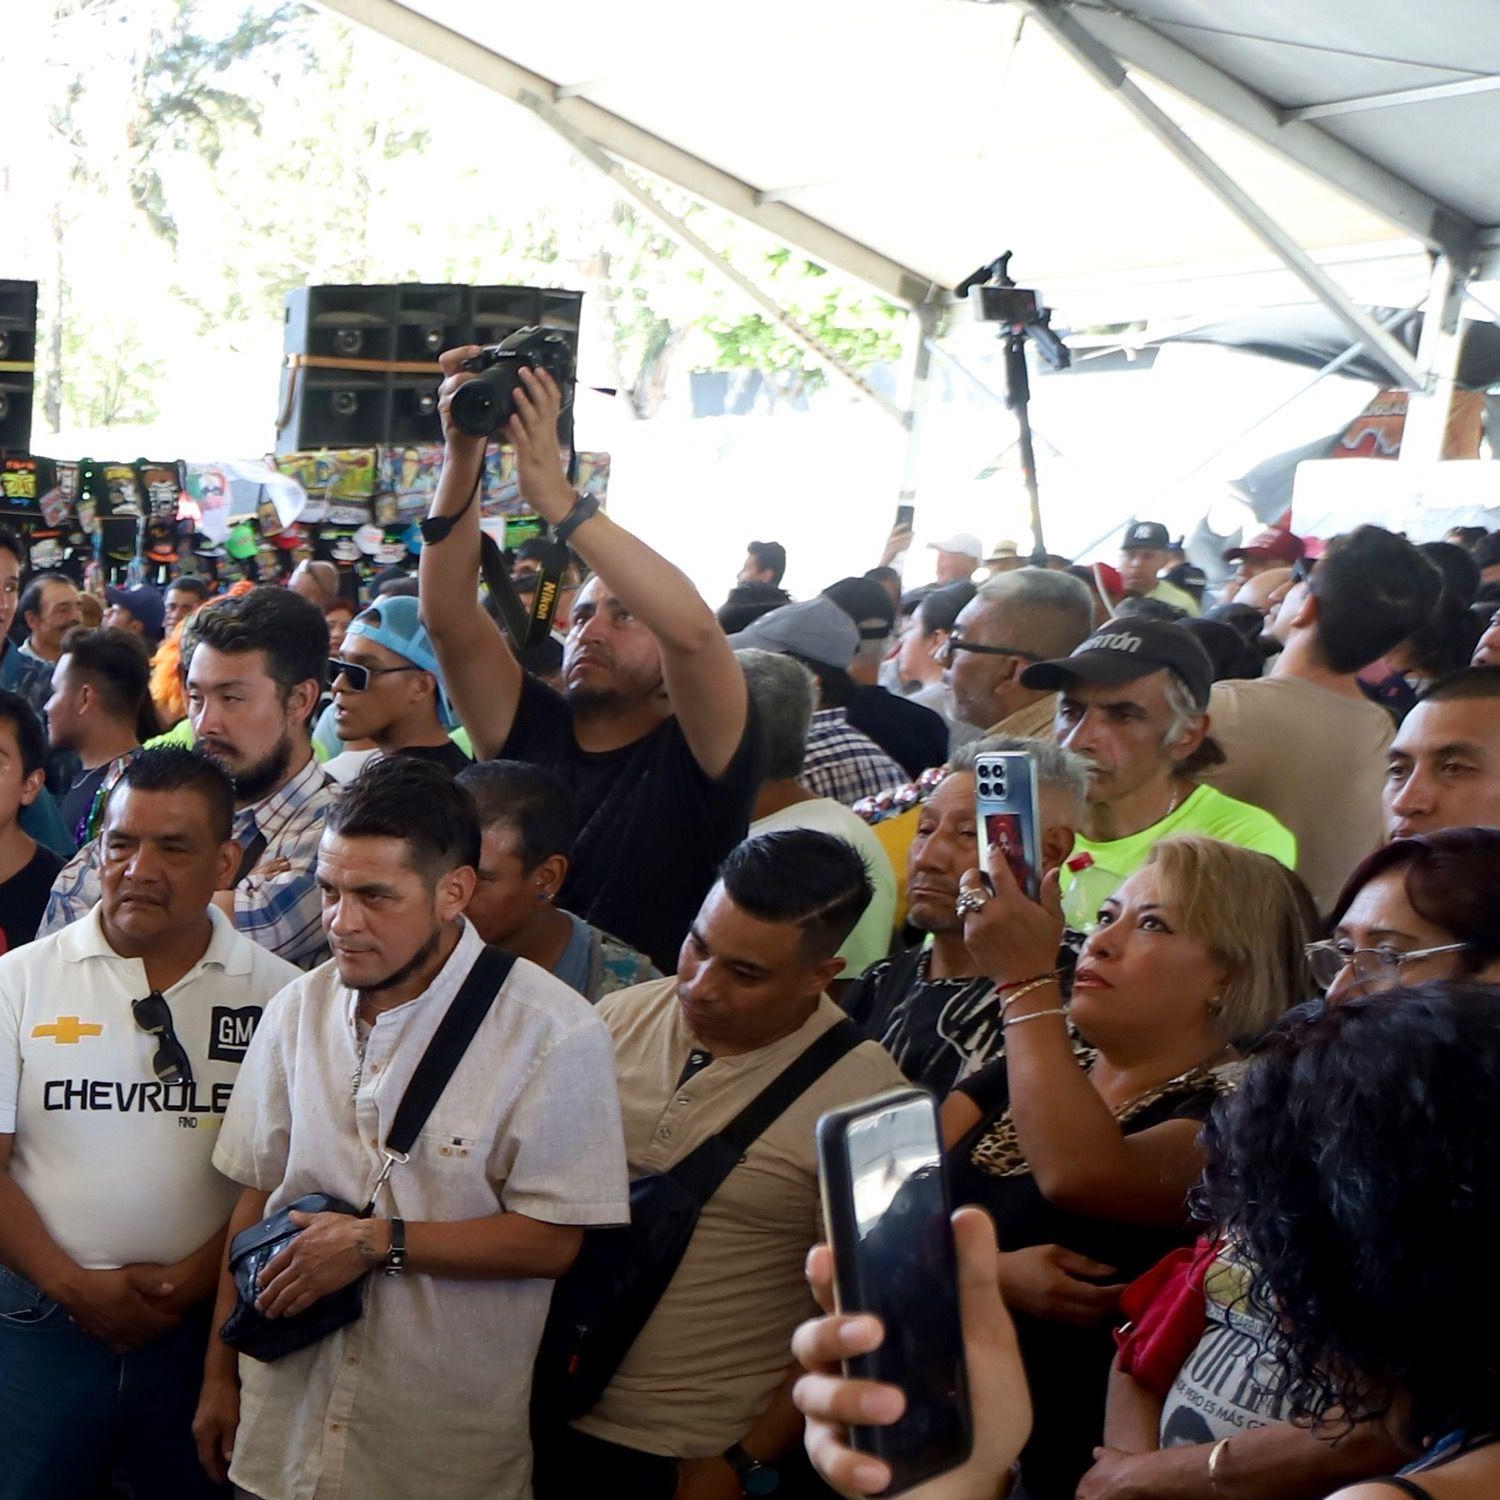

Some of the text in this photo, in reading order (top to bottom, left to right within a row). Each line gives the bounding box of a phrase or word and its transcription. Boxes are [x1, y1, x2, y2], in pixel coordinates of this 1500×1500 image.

[536, 581, 557, 620] Nikon
[219, 1015, 254, 1044] GM
[43, 1078, 235, 1113] CHEVROLE
[178, 1116, 198, 1128] FIND
[1216, 1405, 1244, 1428] MÁS
